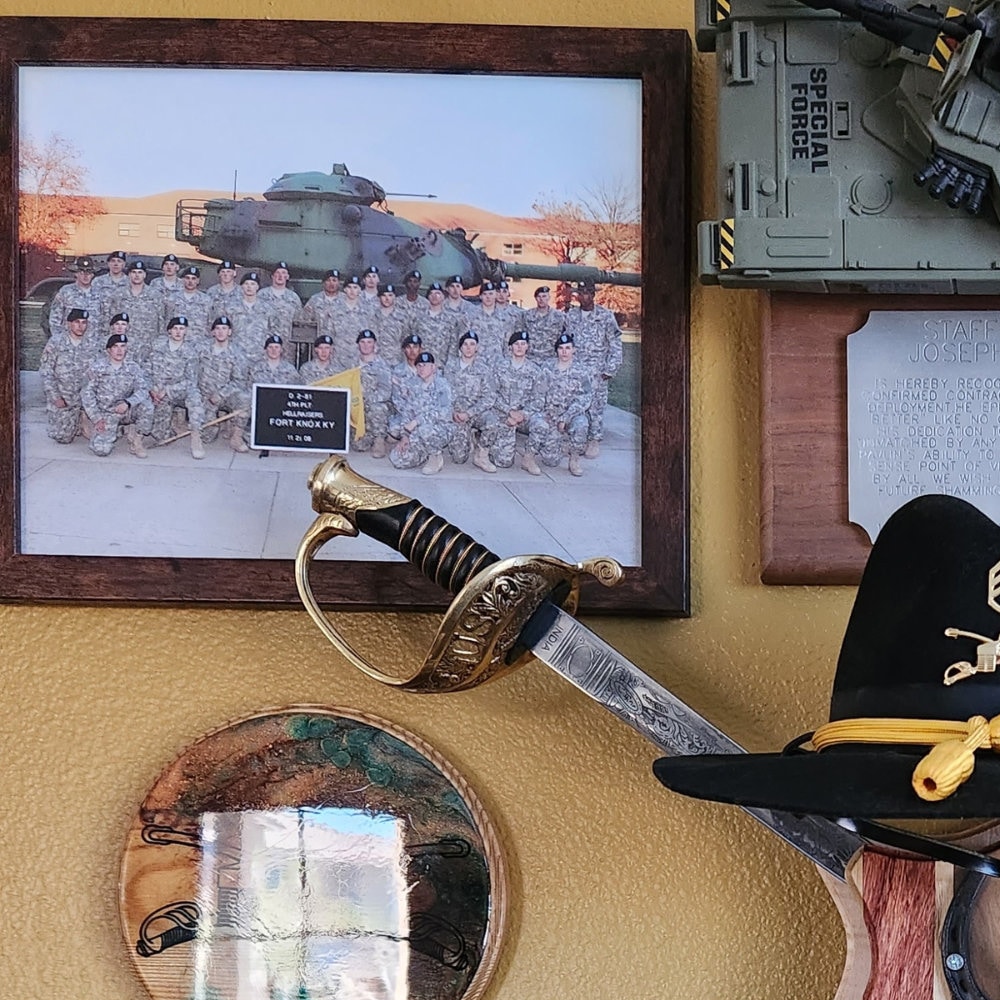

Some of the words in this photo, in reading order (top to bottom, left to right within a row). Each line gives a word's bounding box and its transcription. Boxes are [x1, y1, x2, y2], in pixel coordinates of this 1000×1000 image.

[791, 82, 809, 159] FORCE
[810, 68, 828, 173] SPECIAL
[923, 319, 998, 340] STAFF
[896, 377, 948, 389] HEREBY
[269, 418, 293, 427] FORT
[296, 420, 321, 428] KNOX
[934, 414, 961, 425] LIKE
[971, 414, 988, 425] NO
[908, 426, 982, 436] DEDICATION
[946, 437, 963, 448] BY
[973, 437, 997, 448] ANY
[919, 461, 956, 472] POINT
[873, 473, 890, 485] BY
[933, 473, 952, 485] WE
[541, 624, 563, 652] INDIA
